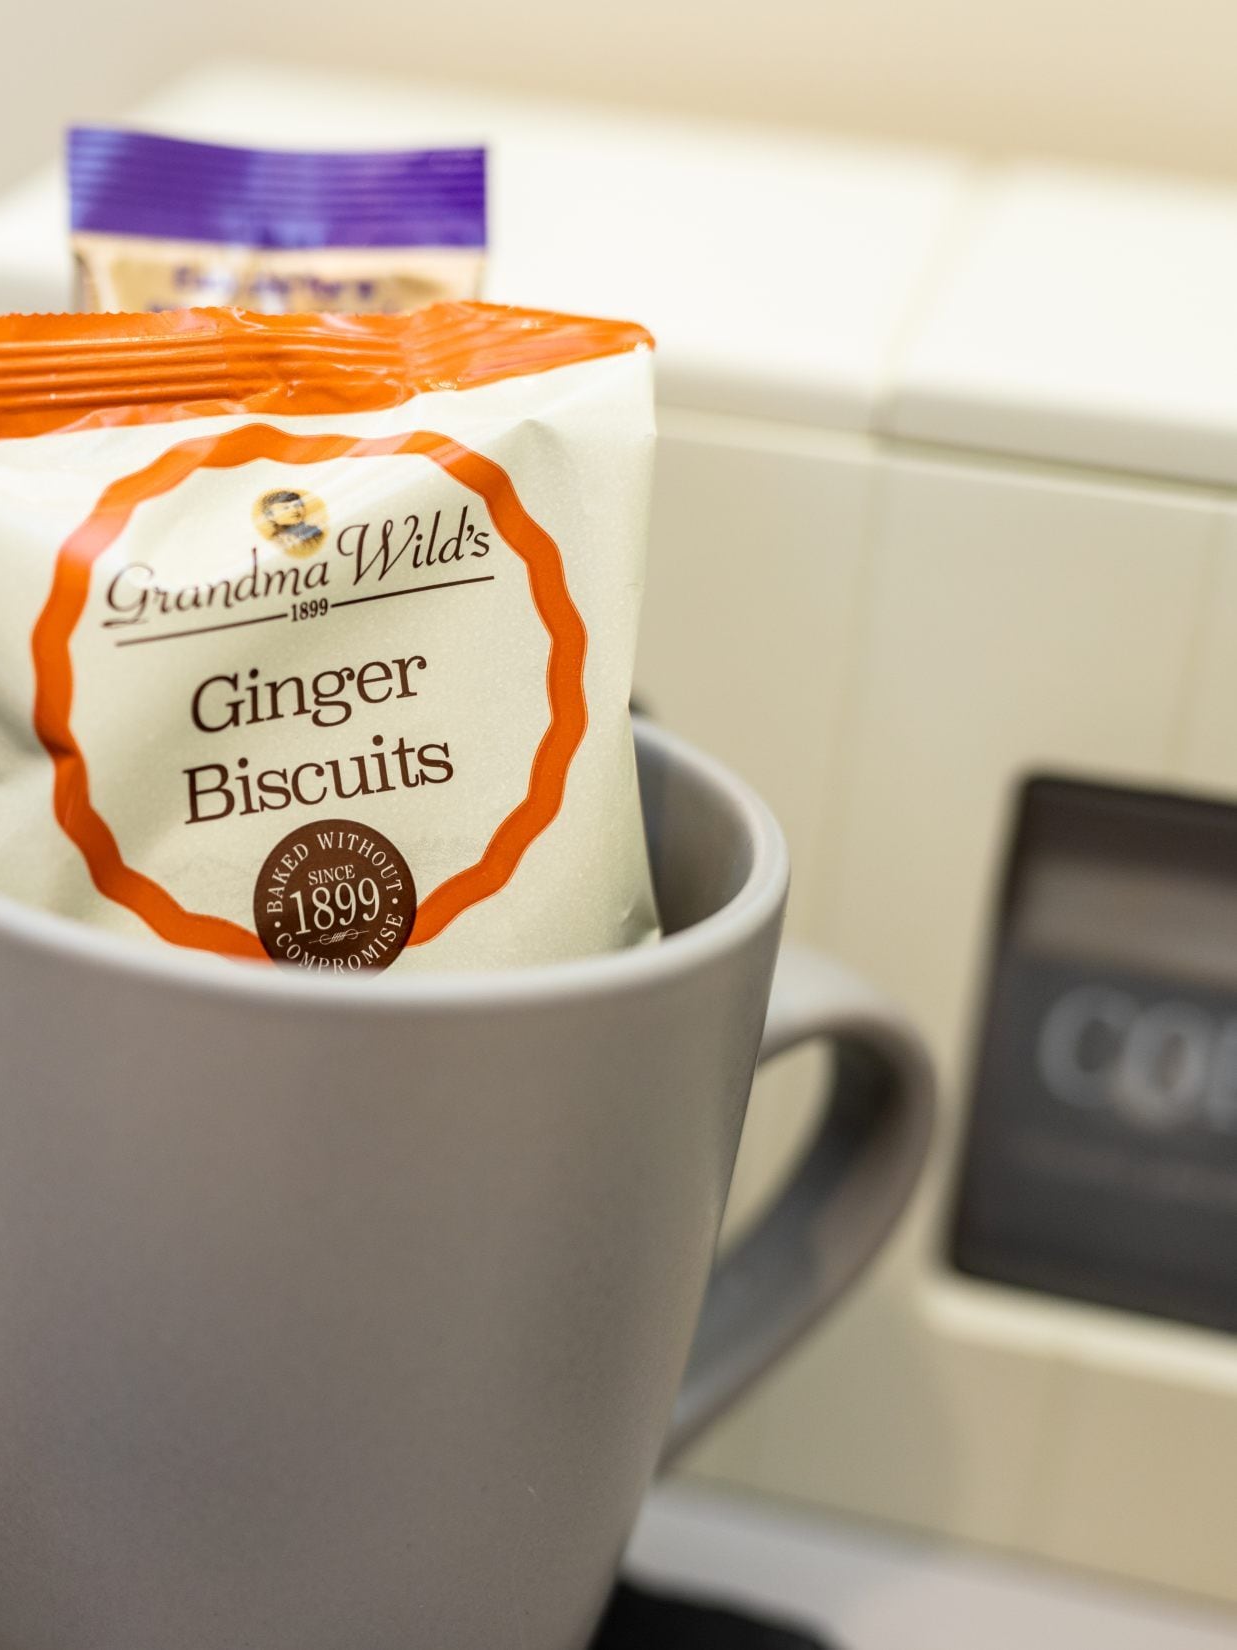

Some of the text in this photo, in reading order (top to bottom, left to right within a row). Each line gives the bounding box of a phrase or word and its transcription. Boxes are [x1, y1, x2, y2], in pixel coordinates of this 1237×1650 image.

[101, 505, 491, 628] Grandma Wild's
[290, 597, 329, 622] 1899
[190, 654, 427, 734] Ginger
[182, 734, 454, 825] Biscuits
[266, 831, 403, 914] BAKED WITHOUT
[289, 877, 381, 936] 1899
[308, 864, 356, 886] SINCE
[276, 913, 404, 975] COMPROMISE
